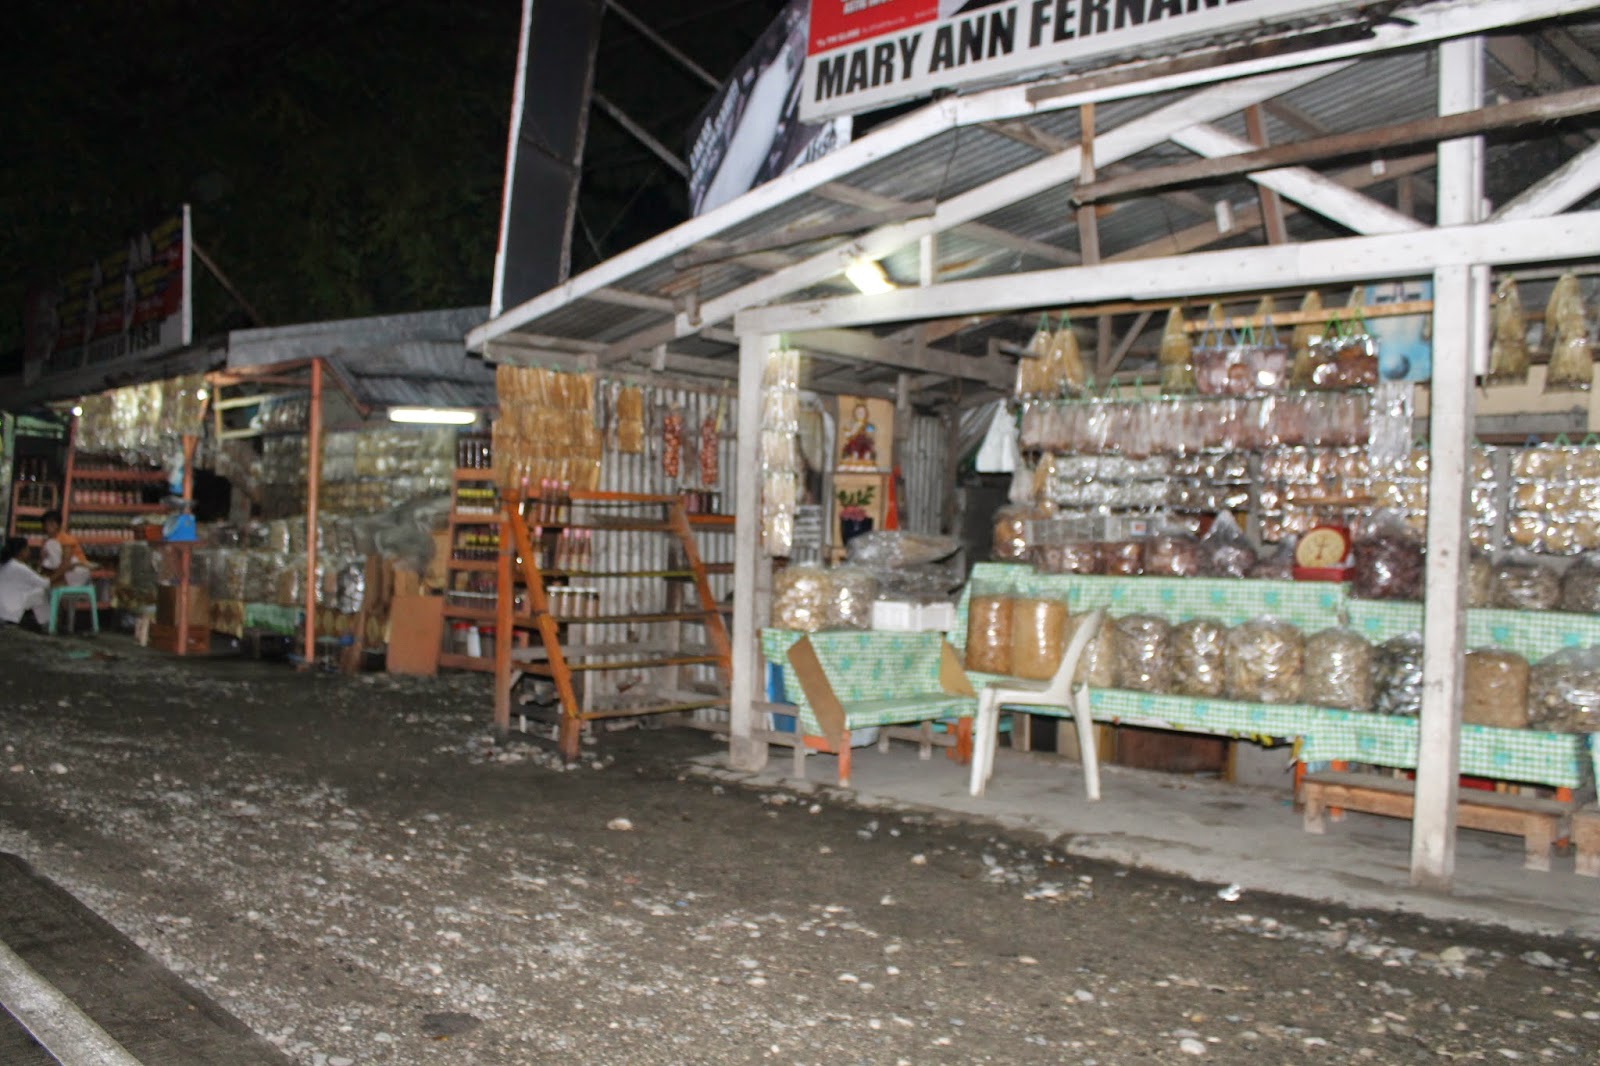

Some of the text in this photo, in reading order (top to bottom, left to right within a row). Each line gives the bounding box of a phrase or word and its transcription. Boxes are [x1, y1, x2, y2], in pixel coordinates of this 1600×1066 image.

[815, 32, 922, 103] MARY
[928, 7, 1017, 73] ANN
[1029, 0, 1247, 48] FERN
